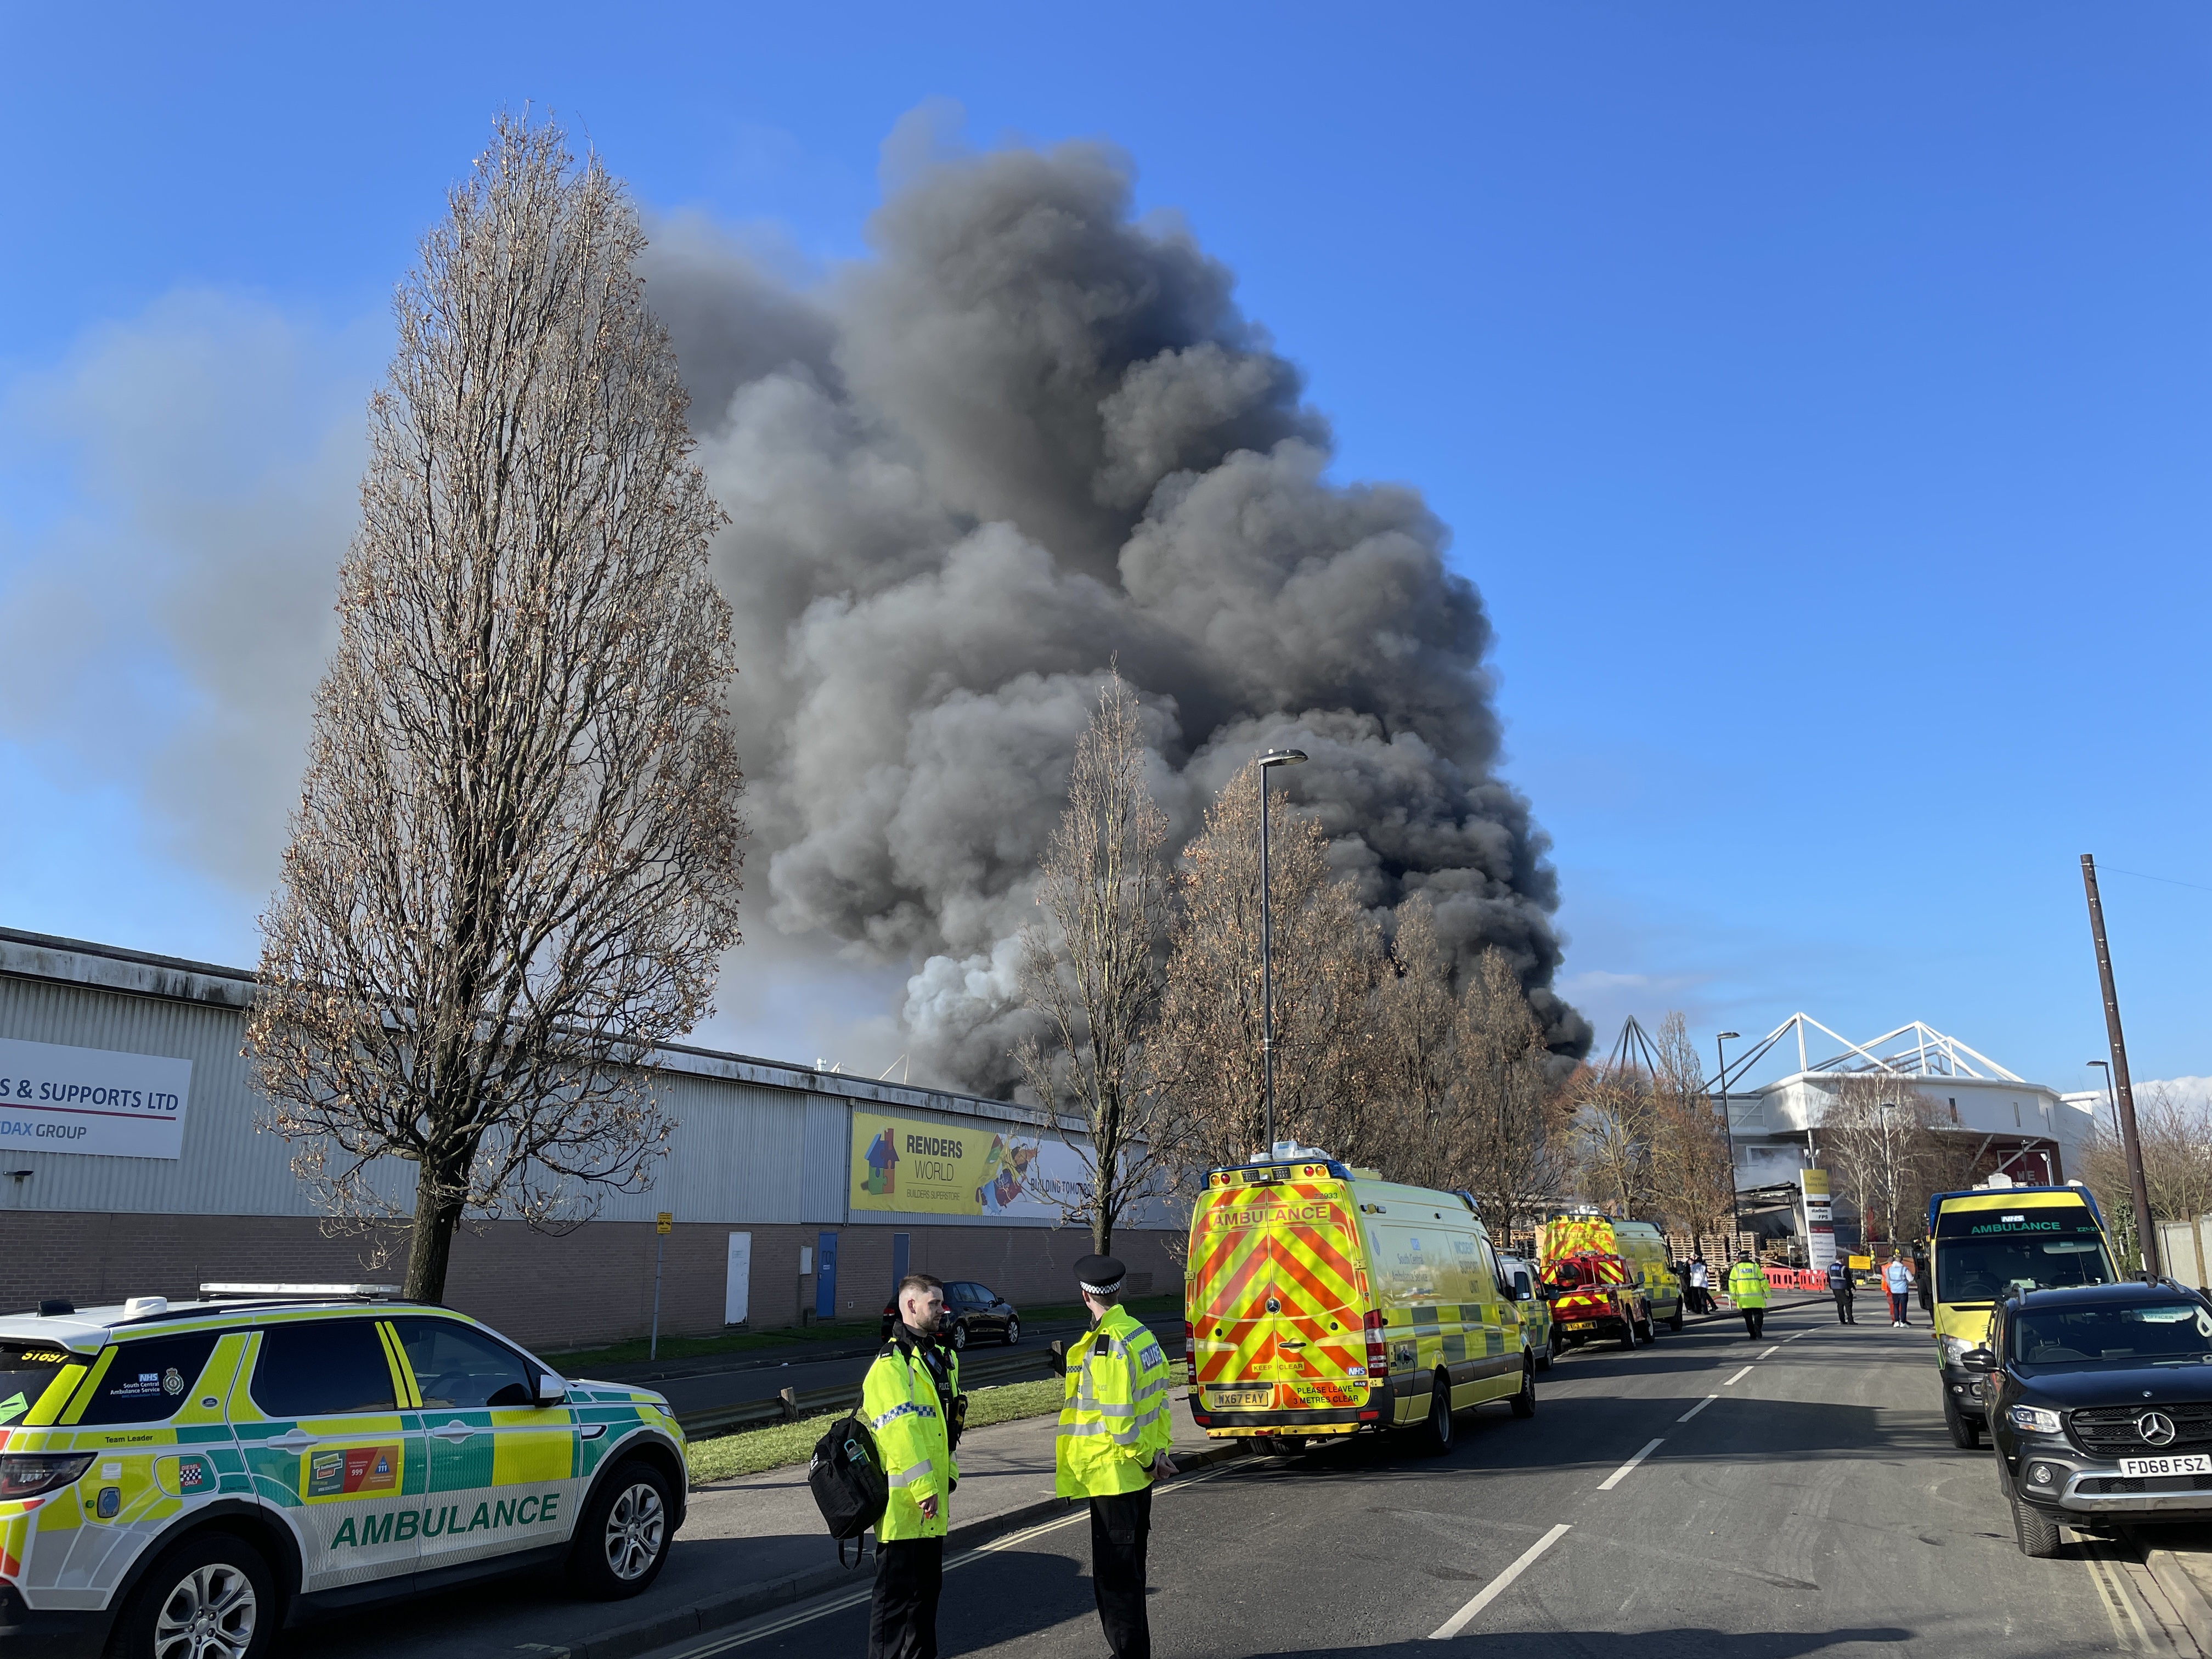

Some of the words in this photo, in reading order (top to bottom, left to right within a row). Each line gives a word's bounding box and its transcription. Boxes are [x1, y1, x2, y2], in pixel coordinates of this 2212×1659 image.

[17, 1080, 32, 1099] &
[39, 1082, 142, 1108] SUPPORTS
[148, 1092, 178, 1110] LTD
[0, 1121, 33, 1136] DAX
[36, 1124, 87, 1139] GROUP
[907, 1134, 962, 1159] RENDERS
[915, 1160, 953, 1181] WORLD
[2017, 1171, 2035, 1181] WE
[1031, 1178, 1060, 1193] BUILDING
[907, 1189, 929, 1199] BUILDERS
[931, 1190, 960, 1201] SUPERSTORE
[1212, 1206, 1328, 1227] AMBULANCE
[1971, 1222, 2061, 1234] AMBULANCE
[1454, 1242, 1474, 1255] INCIDENT
[1397, 1253, 1410, 1265] South
[1410, 1254, 1424, 1265] Central
[1459, 1261, 1480, 1274] SUPPORT
[1392, 1270, 1414, 1282] Ambulance
[1469, 1280, 1480, 1293] UNIT
[1141, 1345, 1161, 1369] POLICE
[1348, 1367, 1365, 1375] NHS
[939, 1382, 950, 1390] POLICE
[1218, 1393, 1242, 1404] WX67
[1245, 1392, 1264, 1403] EAY
[1300, 1396, 1330, 1404] METRES
[127, 1434, 153, 1442] Leader
[2127, 1460, 2170, 1475] FD68
[2173, 1458, 2206, 1472] FSZ
[330, 1493, 560, 1550] AMBULANCE
